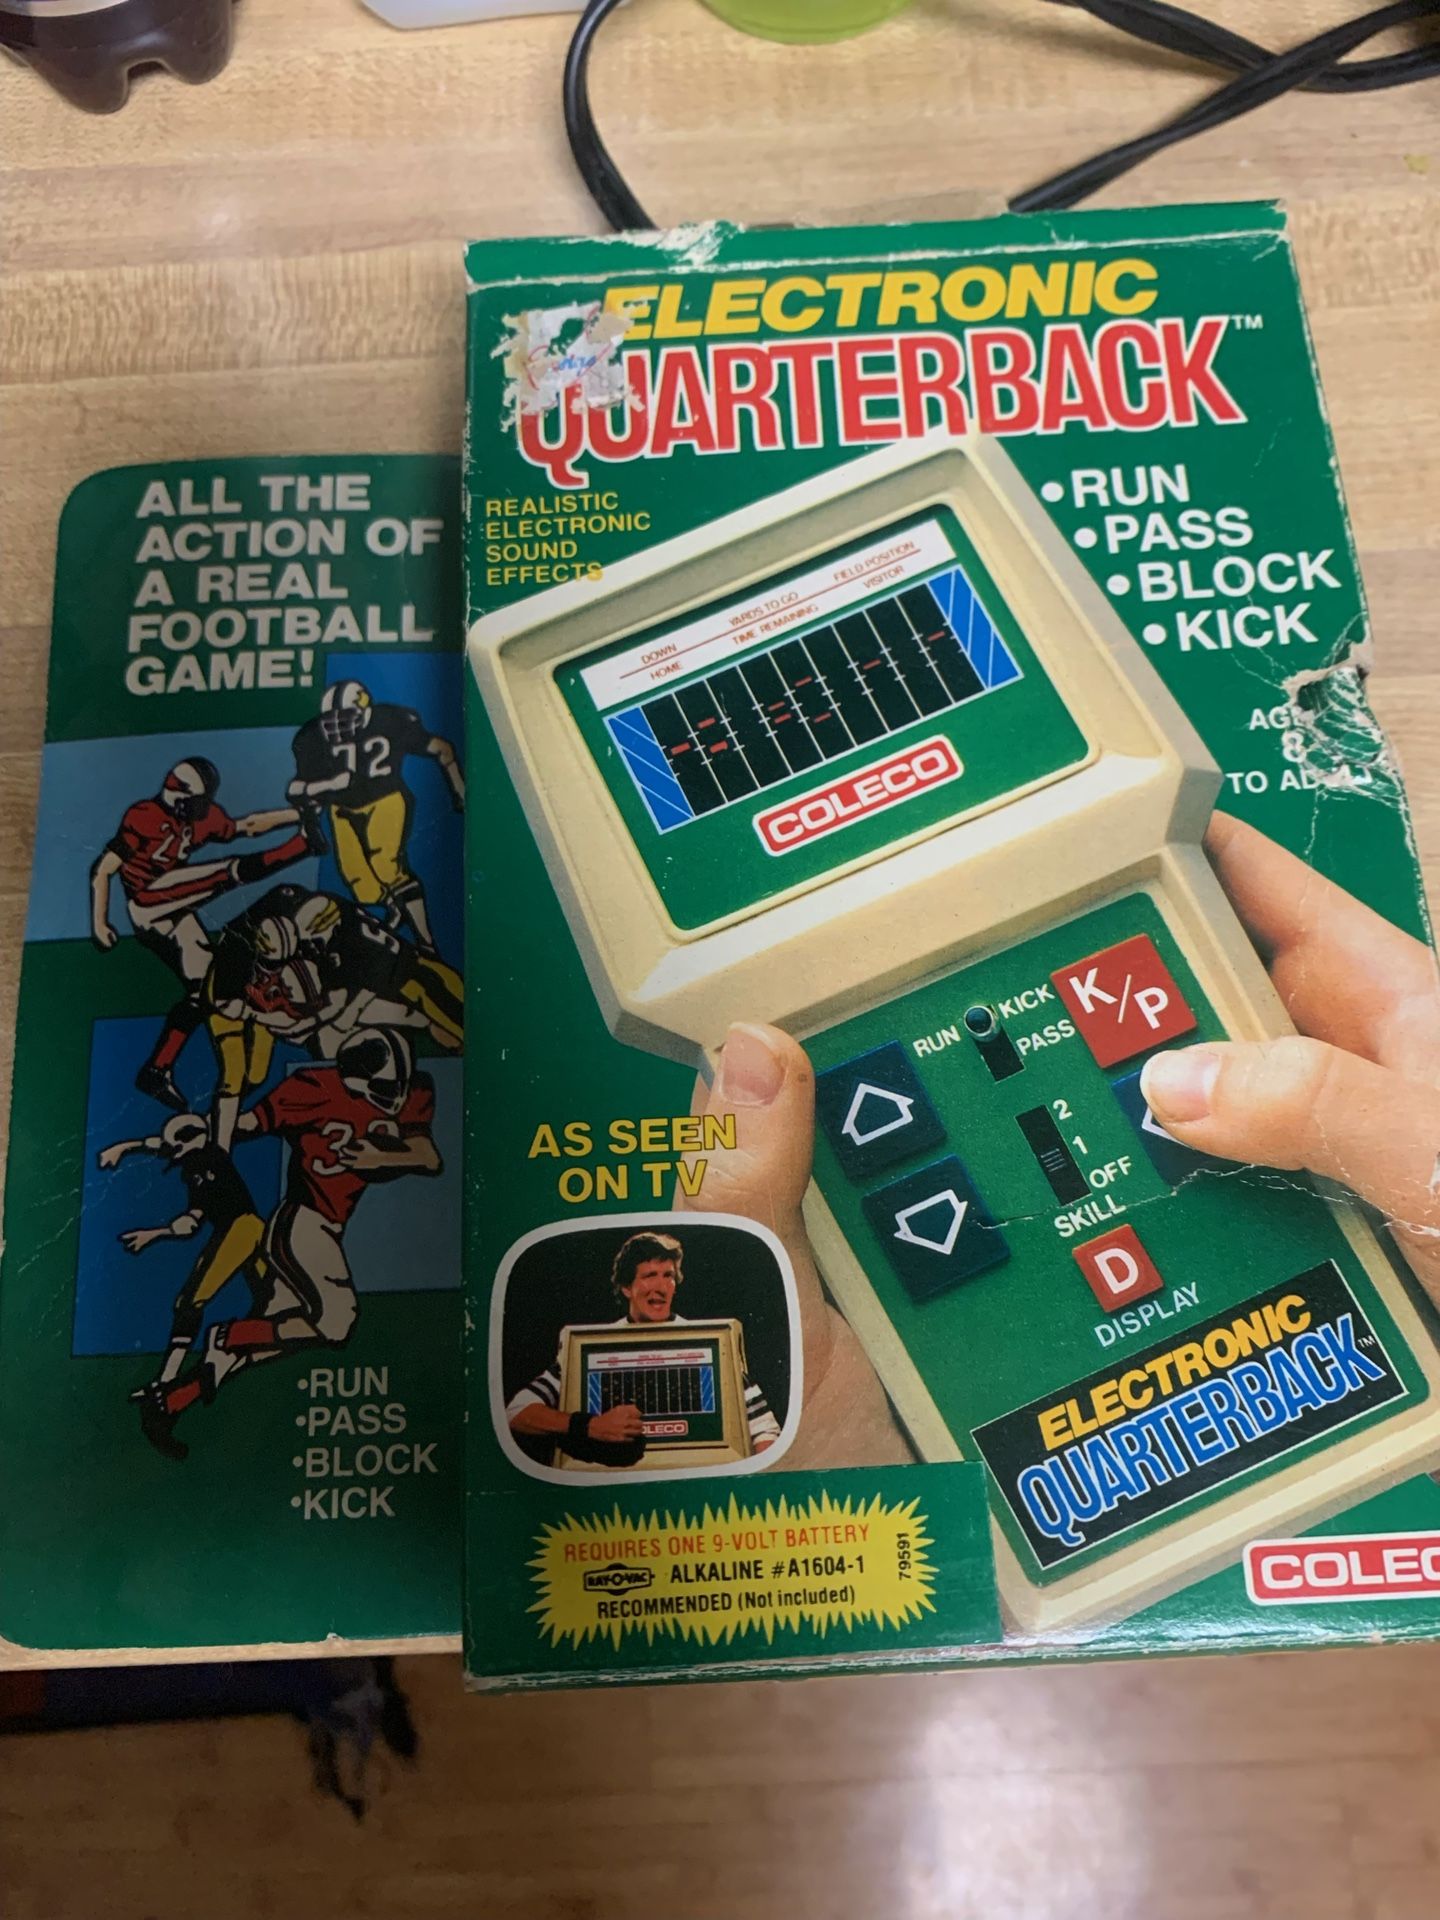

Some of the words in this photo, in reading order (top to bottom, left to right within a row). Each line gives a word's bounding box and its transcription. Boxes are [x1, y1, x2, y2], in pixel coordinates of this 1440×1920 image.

[604, 258, 1159, 341] ELECTRONIC
[136, 477, 242, 518] ALL
[261, 475, 371, 512] THE
[486, 492, 619, 517] REALISTIC
[1071, 464, 1190, 508] RUN
[136, 519, 346, 564] ACTION
[365, 518, 444, 556] OF
[486, 512, 651, 540] ELECTRONIC
[1105, 506, 1253, 554] PASS
[486, 540, 578, 563] SOUND
[833, 564, 863, 581] FIELD
[865, 541, 915, 567] POSITION
[134, 569, 174, 607] A
[197, 562, 348, 604] REAL
[486, 562, 603, 587] EFFECTS
[863, 565, 904, 589] VISITOR
[1138, 549, 1342, 602] BLOCK
[128, 606, 434, 653] FOOTBALL
[729, 606, 764, 627] YARDS
[732, 629, 758, 646] TIME
[759, 603, 820, 634] REMAINING
[1176, 602, 1319, 651] KICK
[125, 650, 314, 696] GAME!
[641, 643, 677, 665] DOWN
[650, 661, 684, 681] HOME
[332, 735, 392, 778] 72
[767, 748, 950, 843] COLECO
[1225, 770, 1268, 794] TO
[999, 984, 1055, 1018] KICK
[1069, 967, 1169, 1029] K/P
[912, 1025, 961, 1058] RUN
[1016, 1019, 1076, 1056] PASS
[1053, 1100, 1072, 1120] 2
[528, 1122, 593, 1158] AS
[608, 1114, 736, 1154] SEEN
[1072, 1136, 1088, 1154] 1
[558, 1165, 628, 1203] ON
[642, 1159, 707, 1197] TV
[1090, 1157, 1132, 1188] OFF
[1055, 1195, 1126, 1237] SKILL
[1094, 1248, 1138, 1293] D
[1094, 1282, 1200, 1348] DISPLAY
[310, 1366, 388, 1398] RUN
[1038, 1294, 1312, 1451] ELECTRONIC
[308, 1402, 406, 1436] PASS
[641, 1424, 685, 1434] LECO
[1017, 1313, 1387, 1547] QUARTERBACK
[306, 1443, 438, 1478] BLOCK
[304, 1486, 396, 1520] KICK
[564, 1538, 661, 1563] REQUIRES
[668, 1535, 705, 1556] ONE
[713, 1530, 778, 1552] 9-VOLT
[786, 1524, 869, 1547] BATTERY
[897, 1532, 911, 1581] 79591
[670, 1559, 763, 1584] ALKALINE
[597, 1593, 732, 1619] RECOMMENDED
[738, 1590, 772, 1611] (Not
[778, 1585, 855, 1606] included)
